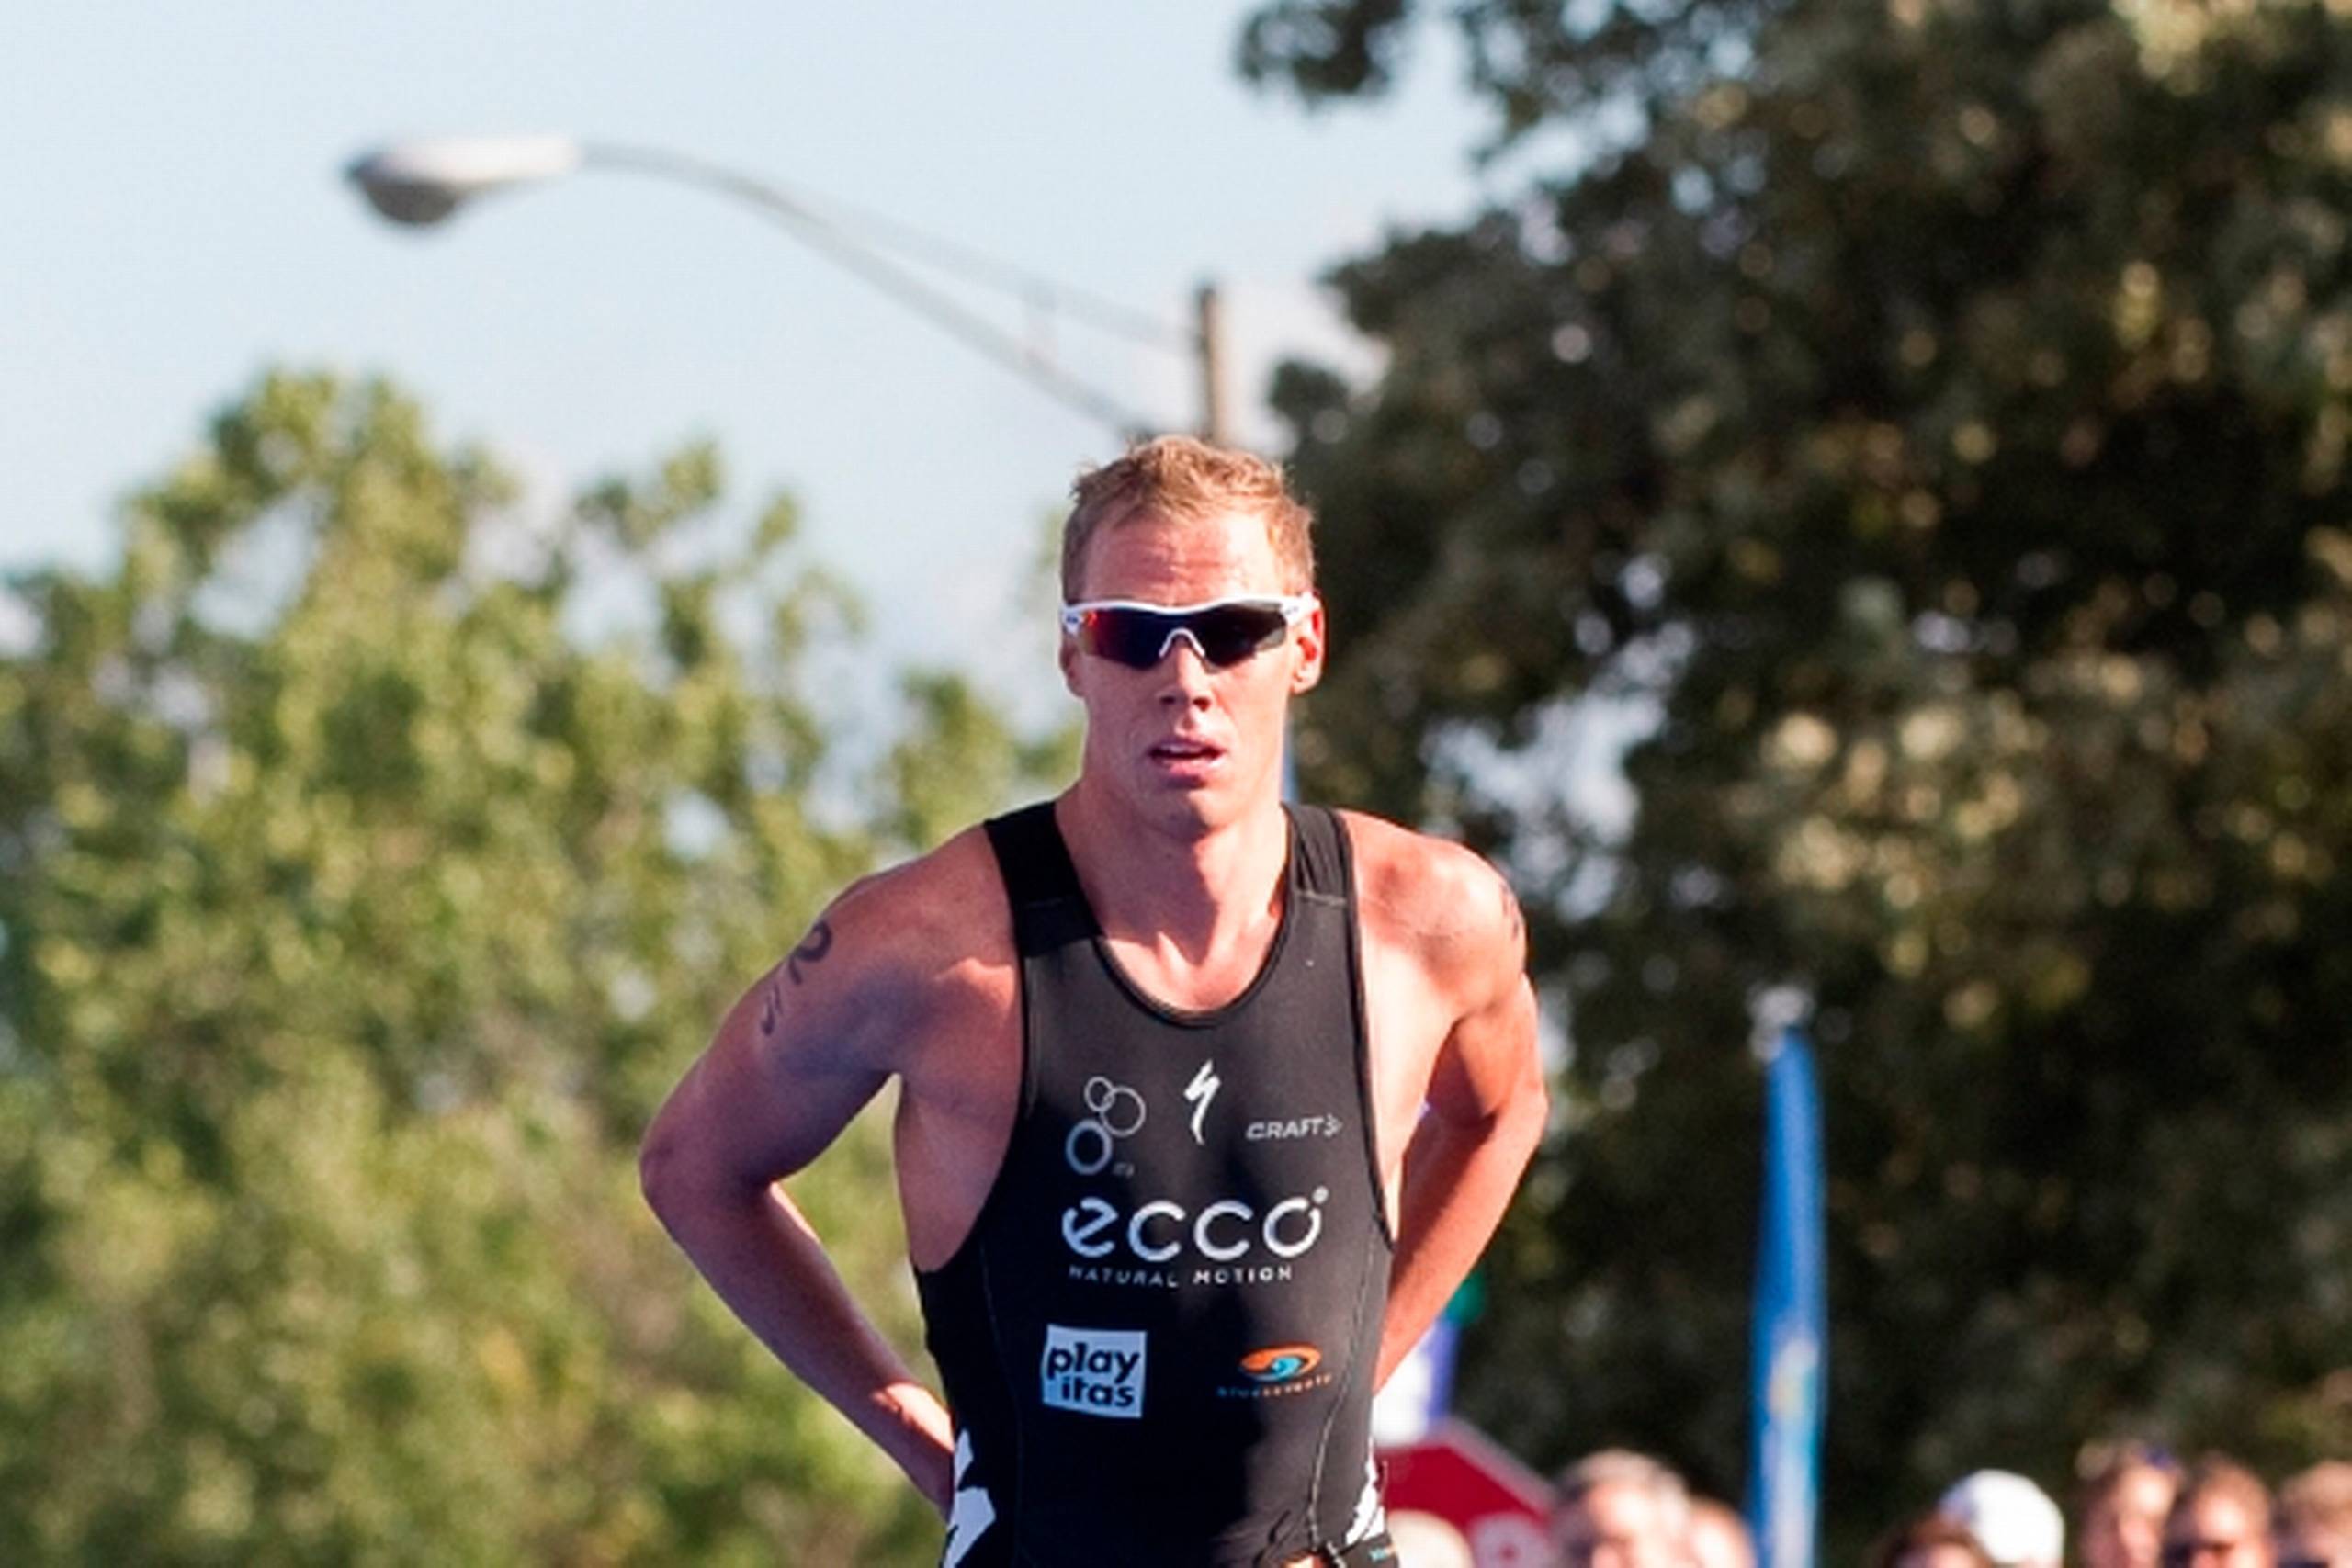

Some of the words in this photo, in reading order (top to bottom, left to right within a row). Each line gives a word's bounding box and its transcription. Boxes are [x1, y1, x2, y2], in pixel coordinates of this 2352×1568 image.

[1246, 1116, 1324, 1139] CRAFT
[1061, 1186, 1329, 1261] ecco
[1068, 1264, 1180, 1288] NATURAL
[1193, 1264, 1293, 1285] MOTION
[1047, 1341, 1140, 1384] play
